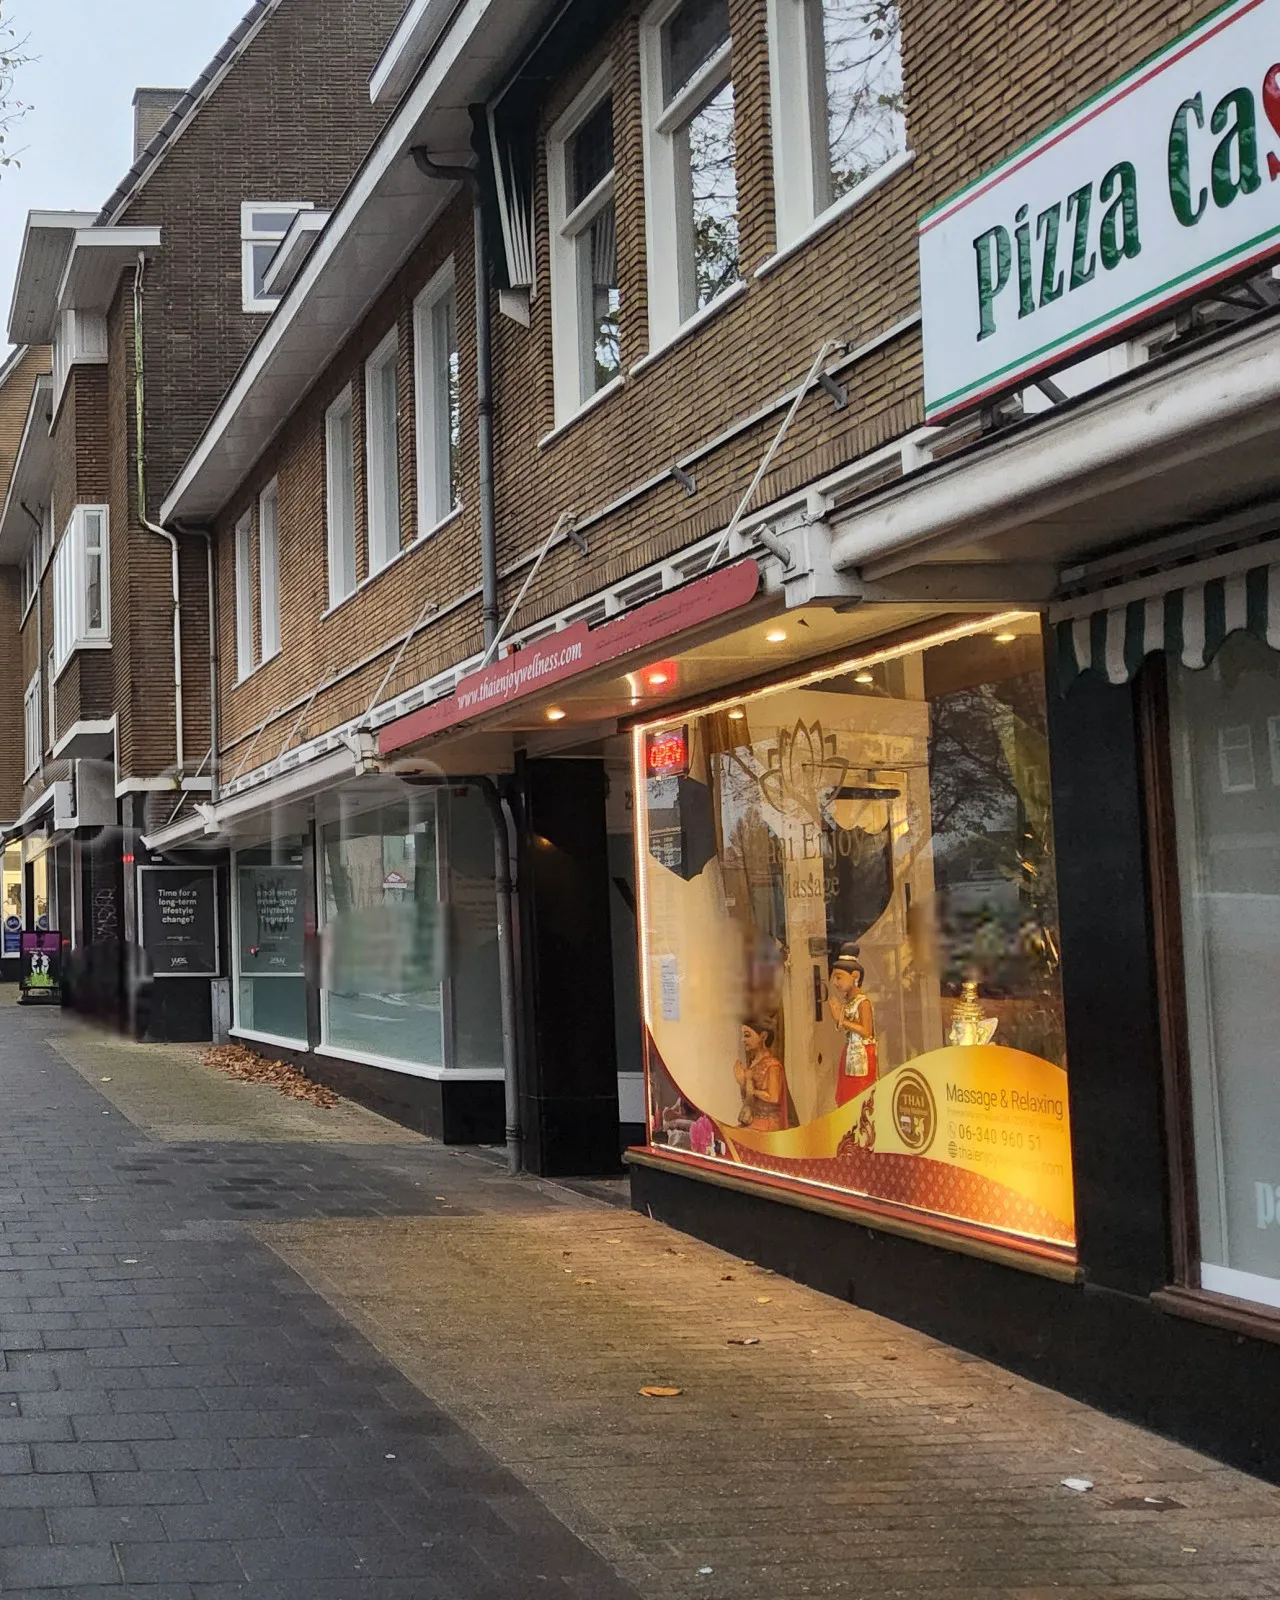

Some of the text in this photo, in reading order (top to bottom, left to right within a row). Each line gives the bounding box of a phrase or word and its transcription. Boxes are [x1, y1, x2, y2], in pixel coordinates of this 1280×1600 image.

[973, 161, 1141, 342] Pizza
[457, 642, 583, 711] www.thaienjoywellness.com
[158, 889, 177, 897] Time
[179, 889, 190, 897] for
[158, 898, 197, 907] long-term
[162, 907, 194, 916] lifestyle
[162, 916, 195, 925] change?
[902, 1095, 925, 1108] THAI
[946, 1083, 998, 1111] Massage
[1000, 1088, 1008, 1109] &
[1011, 1090, 1064, 1121] Relaxing
[958, 1124, 1041, 1151] 06-340 960 51
